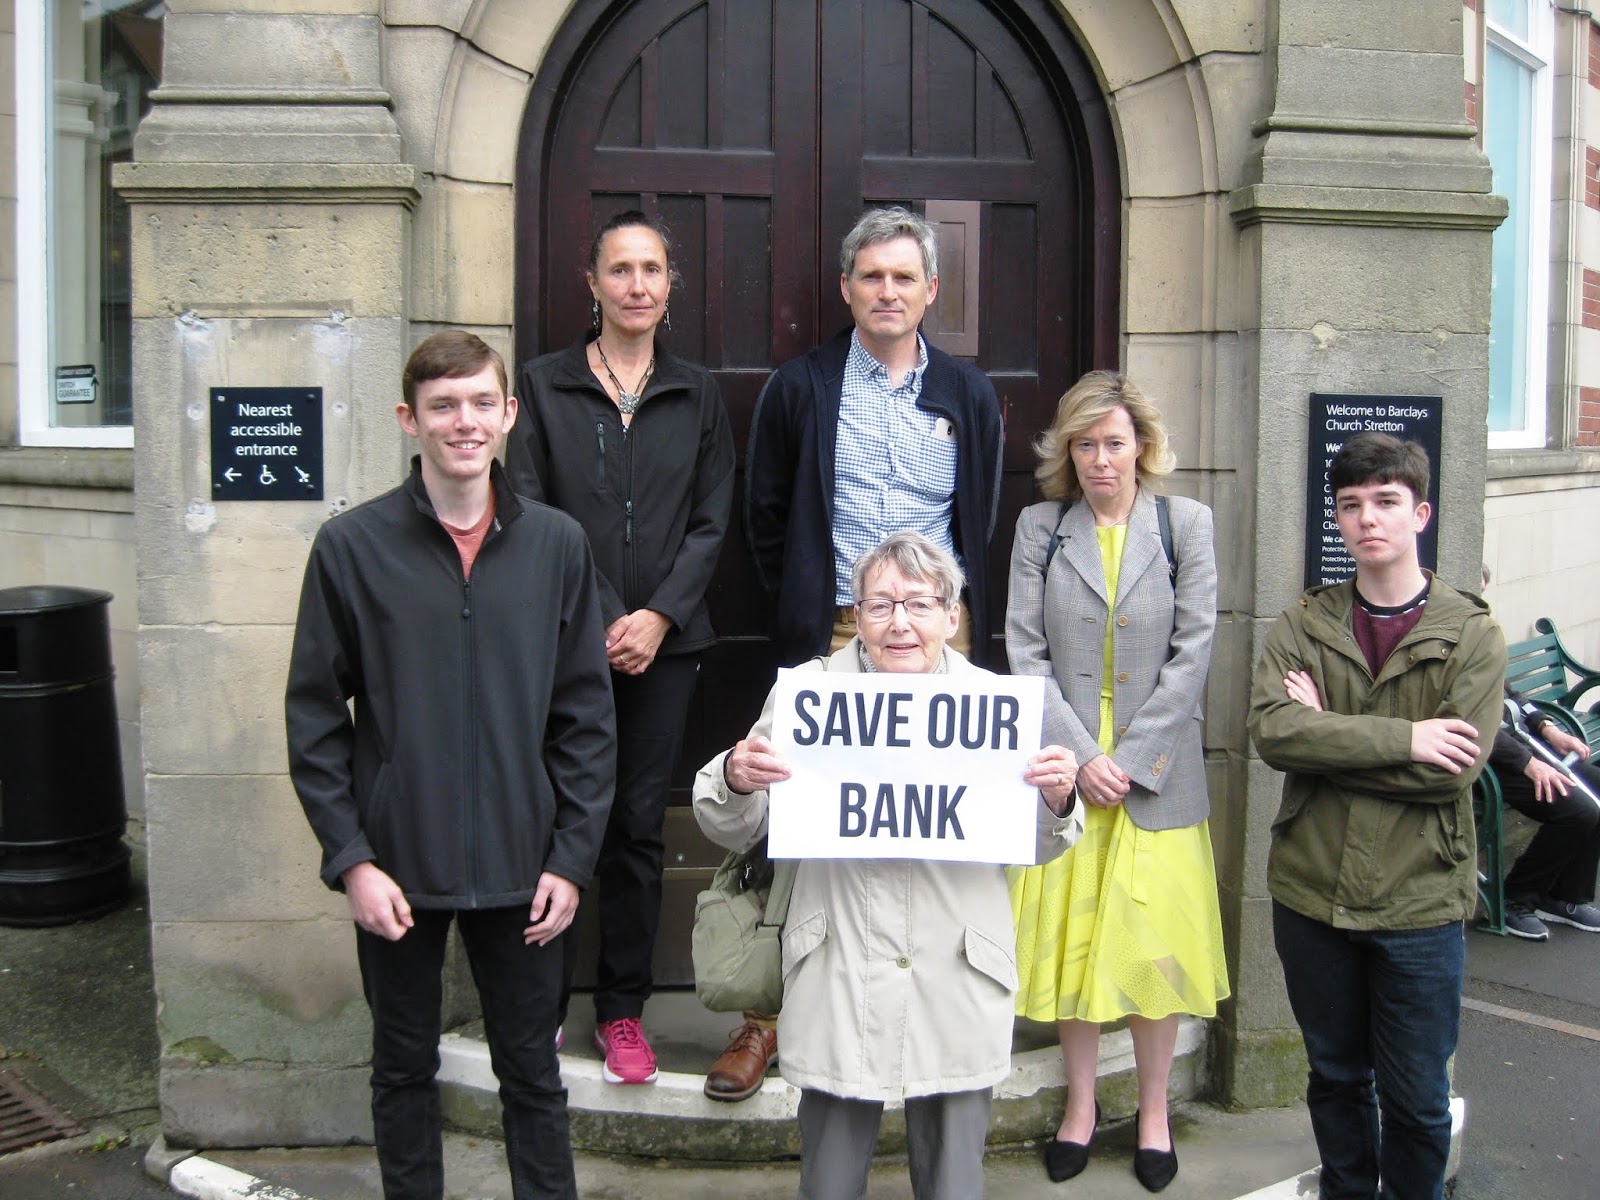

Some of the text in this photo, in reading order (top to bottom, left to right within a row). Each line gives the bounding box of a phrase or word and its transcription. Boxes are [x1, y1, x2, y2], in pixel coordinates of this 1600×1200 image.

[58, 388, 91, 398] GUARANTEE
[238, 403, 293, 416] Nearest
[1325, 404, 1428, 420] Welcome to Barclays
[230, 422, 302, 436] accessible
[1325, 419, 1404, 432] Church Stretton
[235, 444, 298, 456] entrance
[1322, 535, 1334, 543] We
[1321, 555, 1347, 563] Protecting
[1321, 565, 1346, 573] Protecting
[792, 689, 1020, 750] SAVE OUR
[838, 782, 968, 841] BANK
